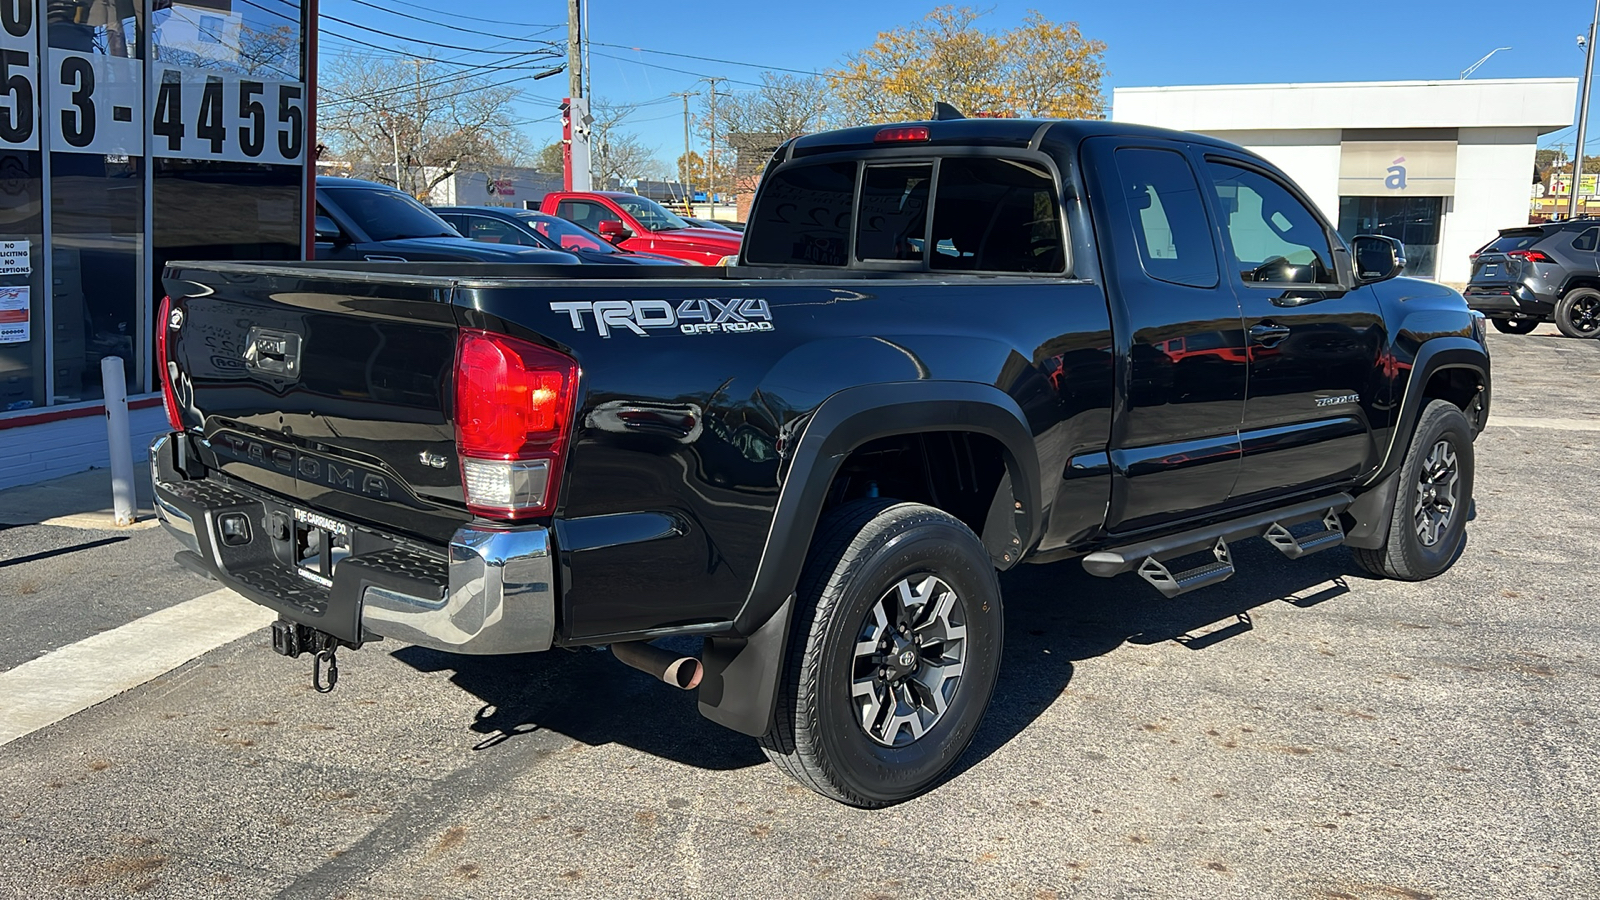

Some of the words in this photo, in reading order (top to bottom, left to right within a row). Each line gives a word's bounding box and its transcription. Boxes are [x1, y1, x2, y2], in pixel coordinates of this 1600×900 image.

[550, 301, 678, 338] TRD
[681, 322, 719, 335] OFF
[722, 320, 775, 333] ROAD
[225, 434, 390, 499] TACOMA
[418, 452, 448, 470] V6
[294, 508, 307, 522] THE
[307, 512, 337, 532] CARRIAGE
